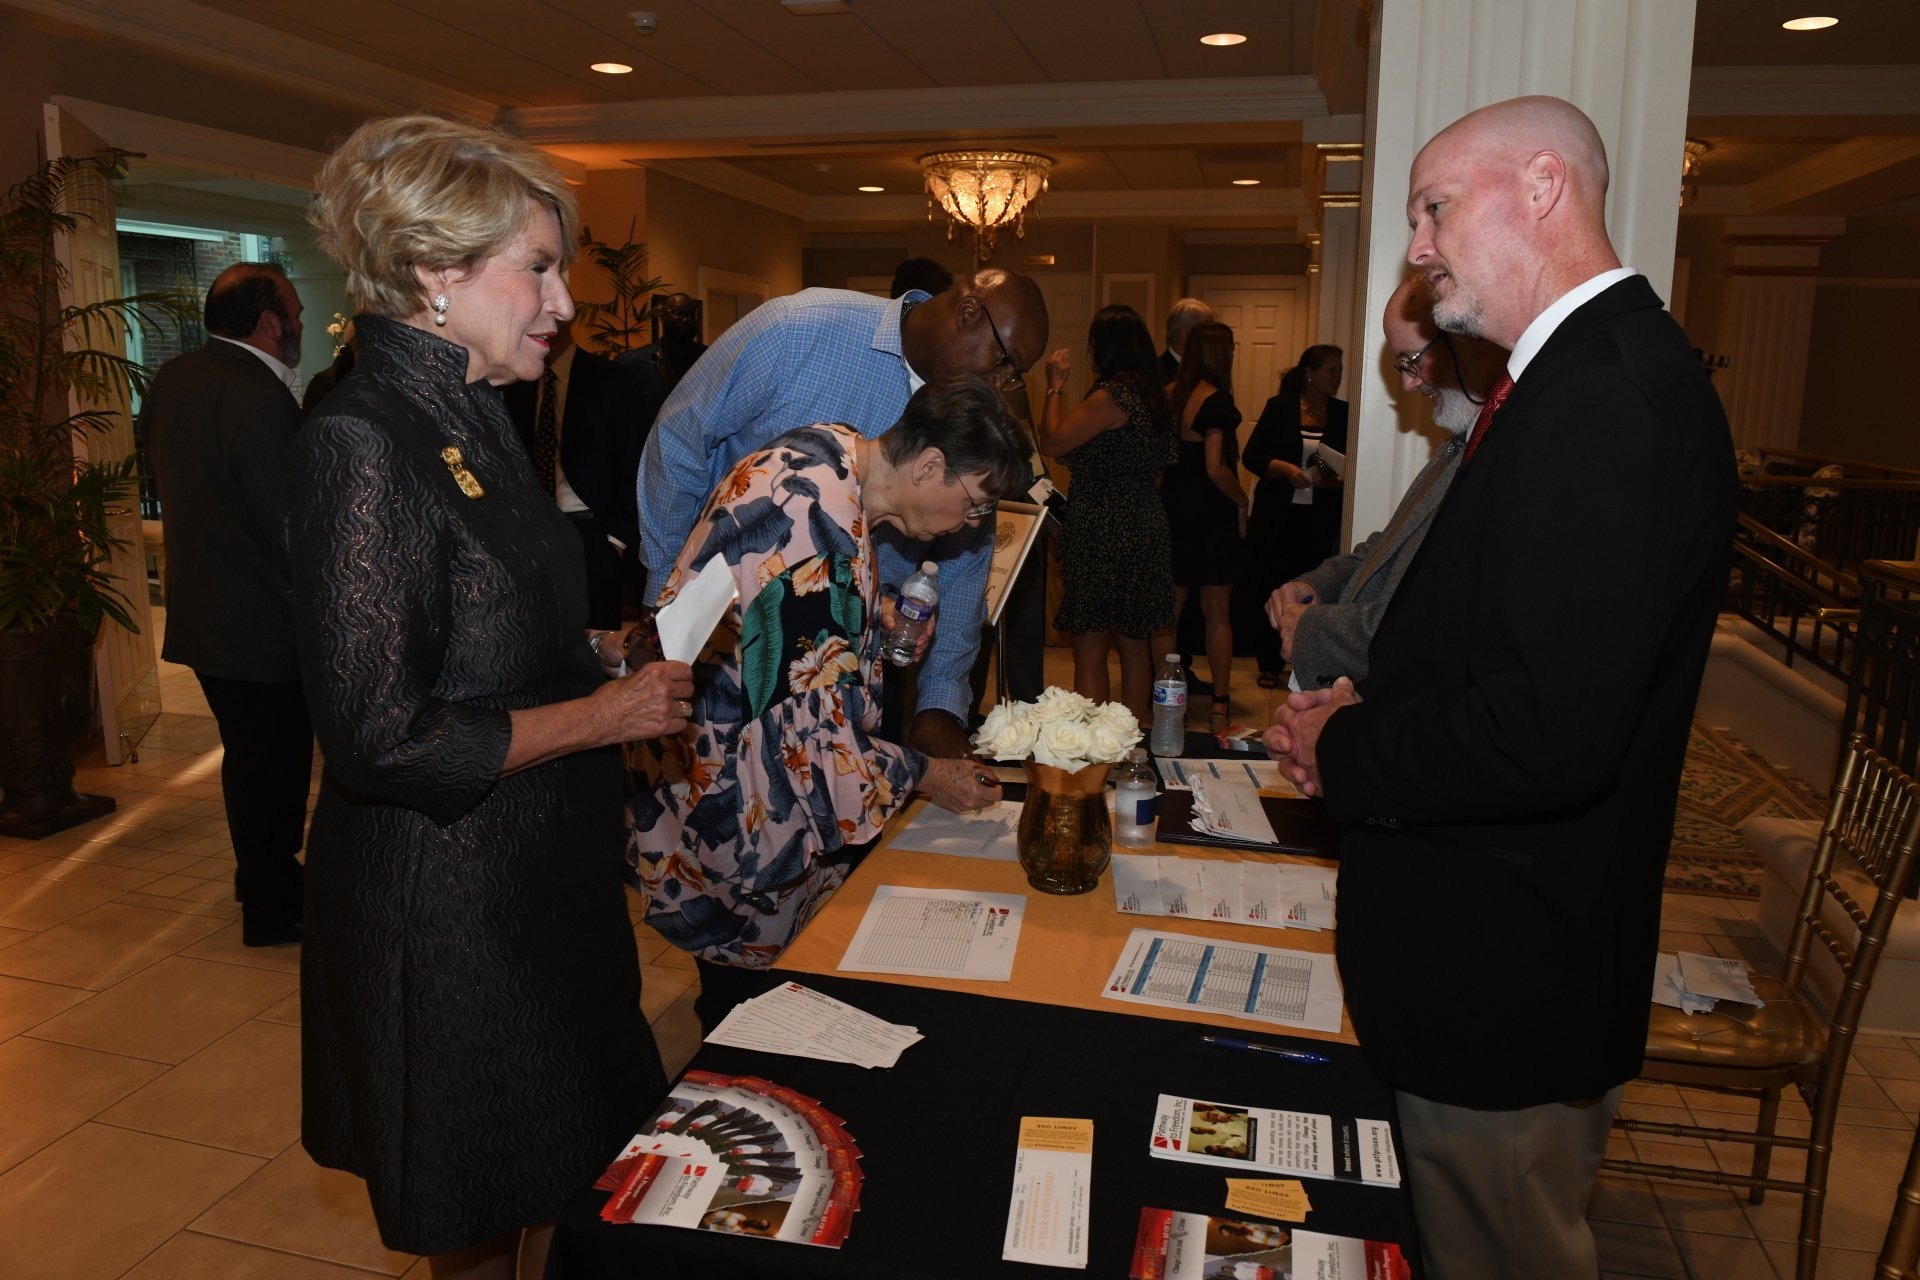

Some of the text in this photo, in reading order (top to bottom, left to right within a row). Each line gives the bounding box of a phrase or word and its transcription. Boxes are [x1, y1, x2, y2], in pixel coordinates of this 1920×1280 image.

[1156, 1114, 1170, 1136] Pathway
[1169, 1108, 1182, 1132] Freedom,
[1372, 1126, 1382, 1178] www.ptfprison.org
[1344, 1158, 1352, 1172] Invest
[682, 1177, 702, 1200] Pathway
[1160, 1240, 1168, 1256] Affects
[1172, 1260, 1182, 1274] Change
